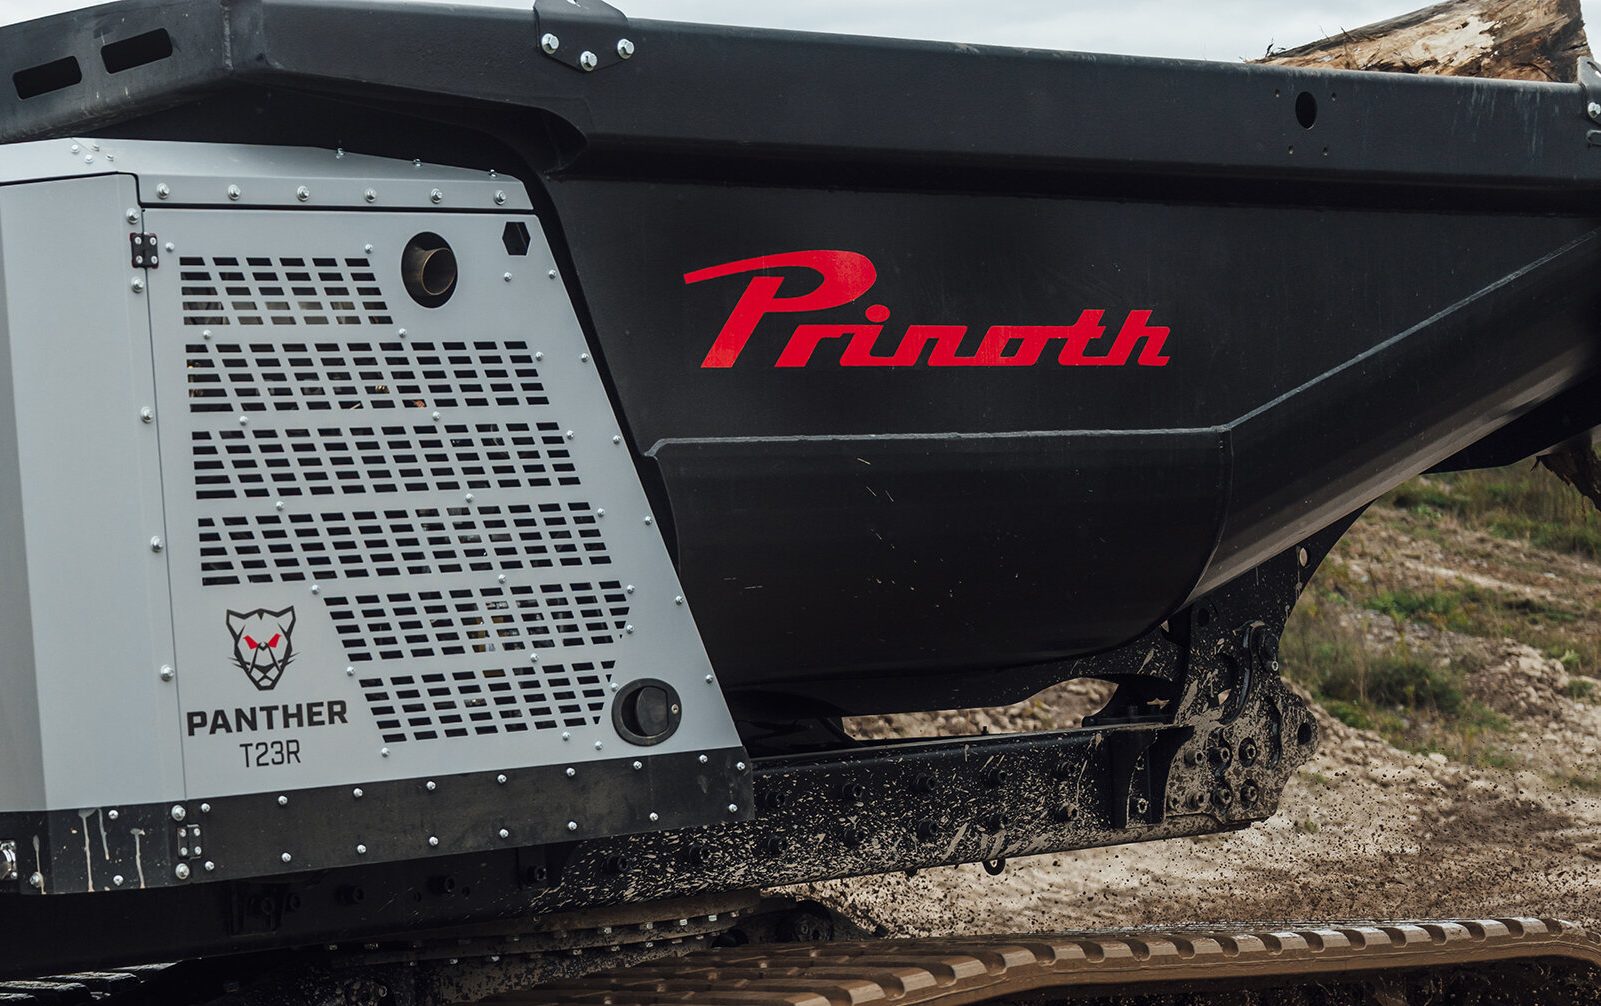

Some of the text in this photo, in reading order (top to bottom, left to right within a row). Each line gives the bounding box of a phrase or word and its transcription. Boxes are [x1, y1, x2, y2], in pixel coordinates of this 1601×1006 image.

[683, 249, 1171, 369] Prinoth
[186, 700, 349, 737] PANTHER
[239, 739, 301, 768] T23R
